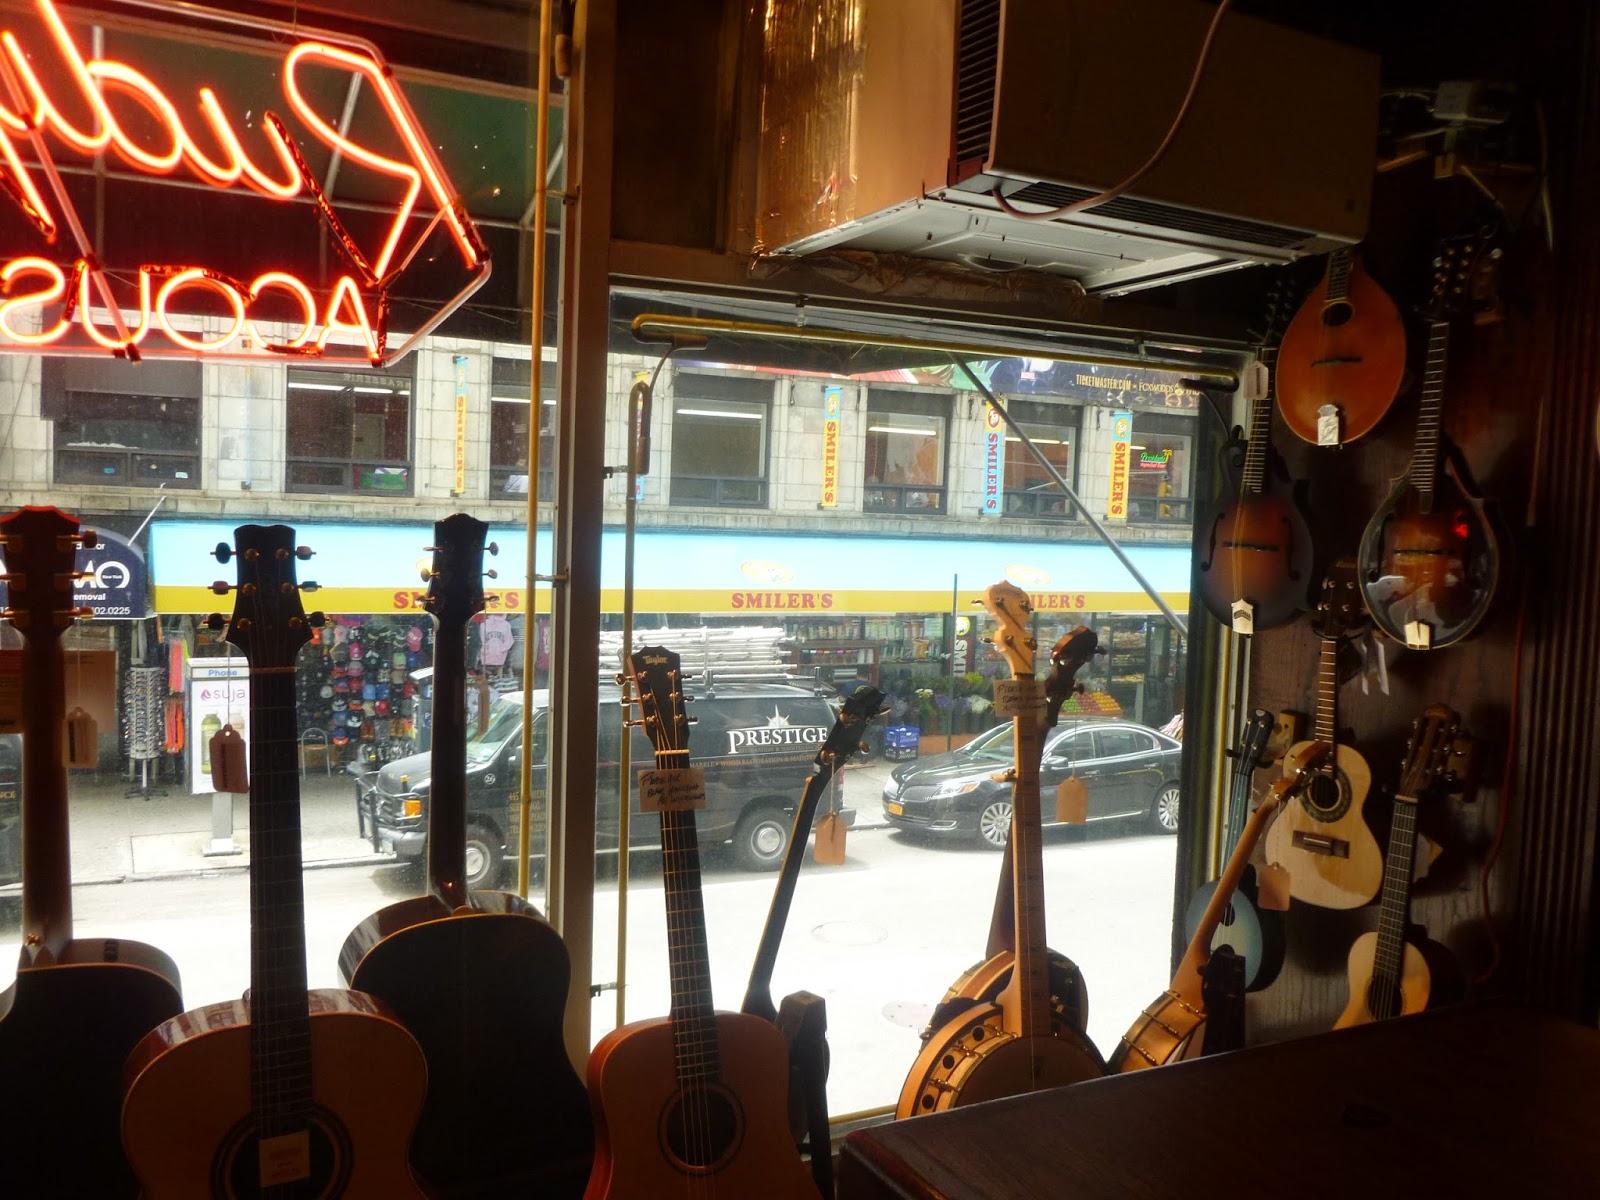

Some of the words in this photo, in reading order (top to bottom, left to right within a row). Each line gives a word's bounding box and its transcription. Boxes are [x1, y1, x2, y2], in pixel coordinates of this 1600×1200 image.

[1076, 374, 1131, 391] TICKETMASTER.COM
[824, 421, 837, 503] SMILER'S
[986, 432, 998, 510] SMILER'S
[1111, 442, 1126, 516] SMILER'S
[74, 593, 106, 601] emoval
[731, 592, 833, 609] SMILER'S
[642, 655, 668, 665] Taylor
[213, 689, 246, 703] suja
[727, 727, 828, 754] PRESTIGE
